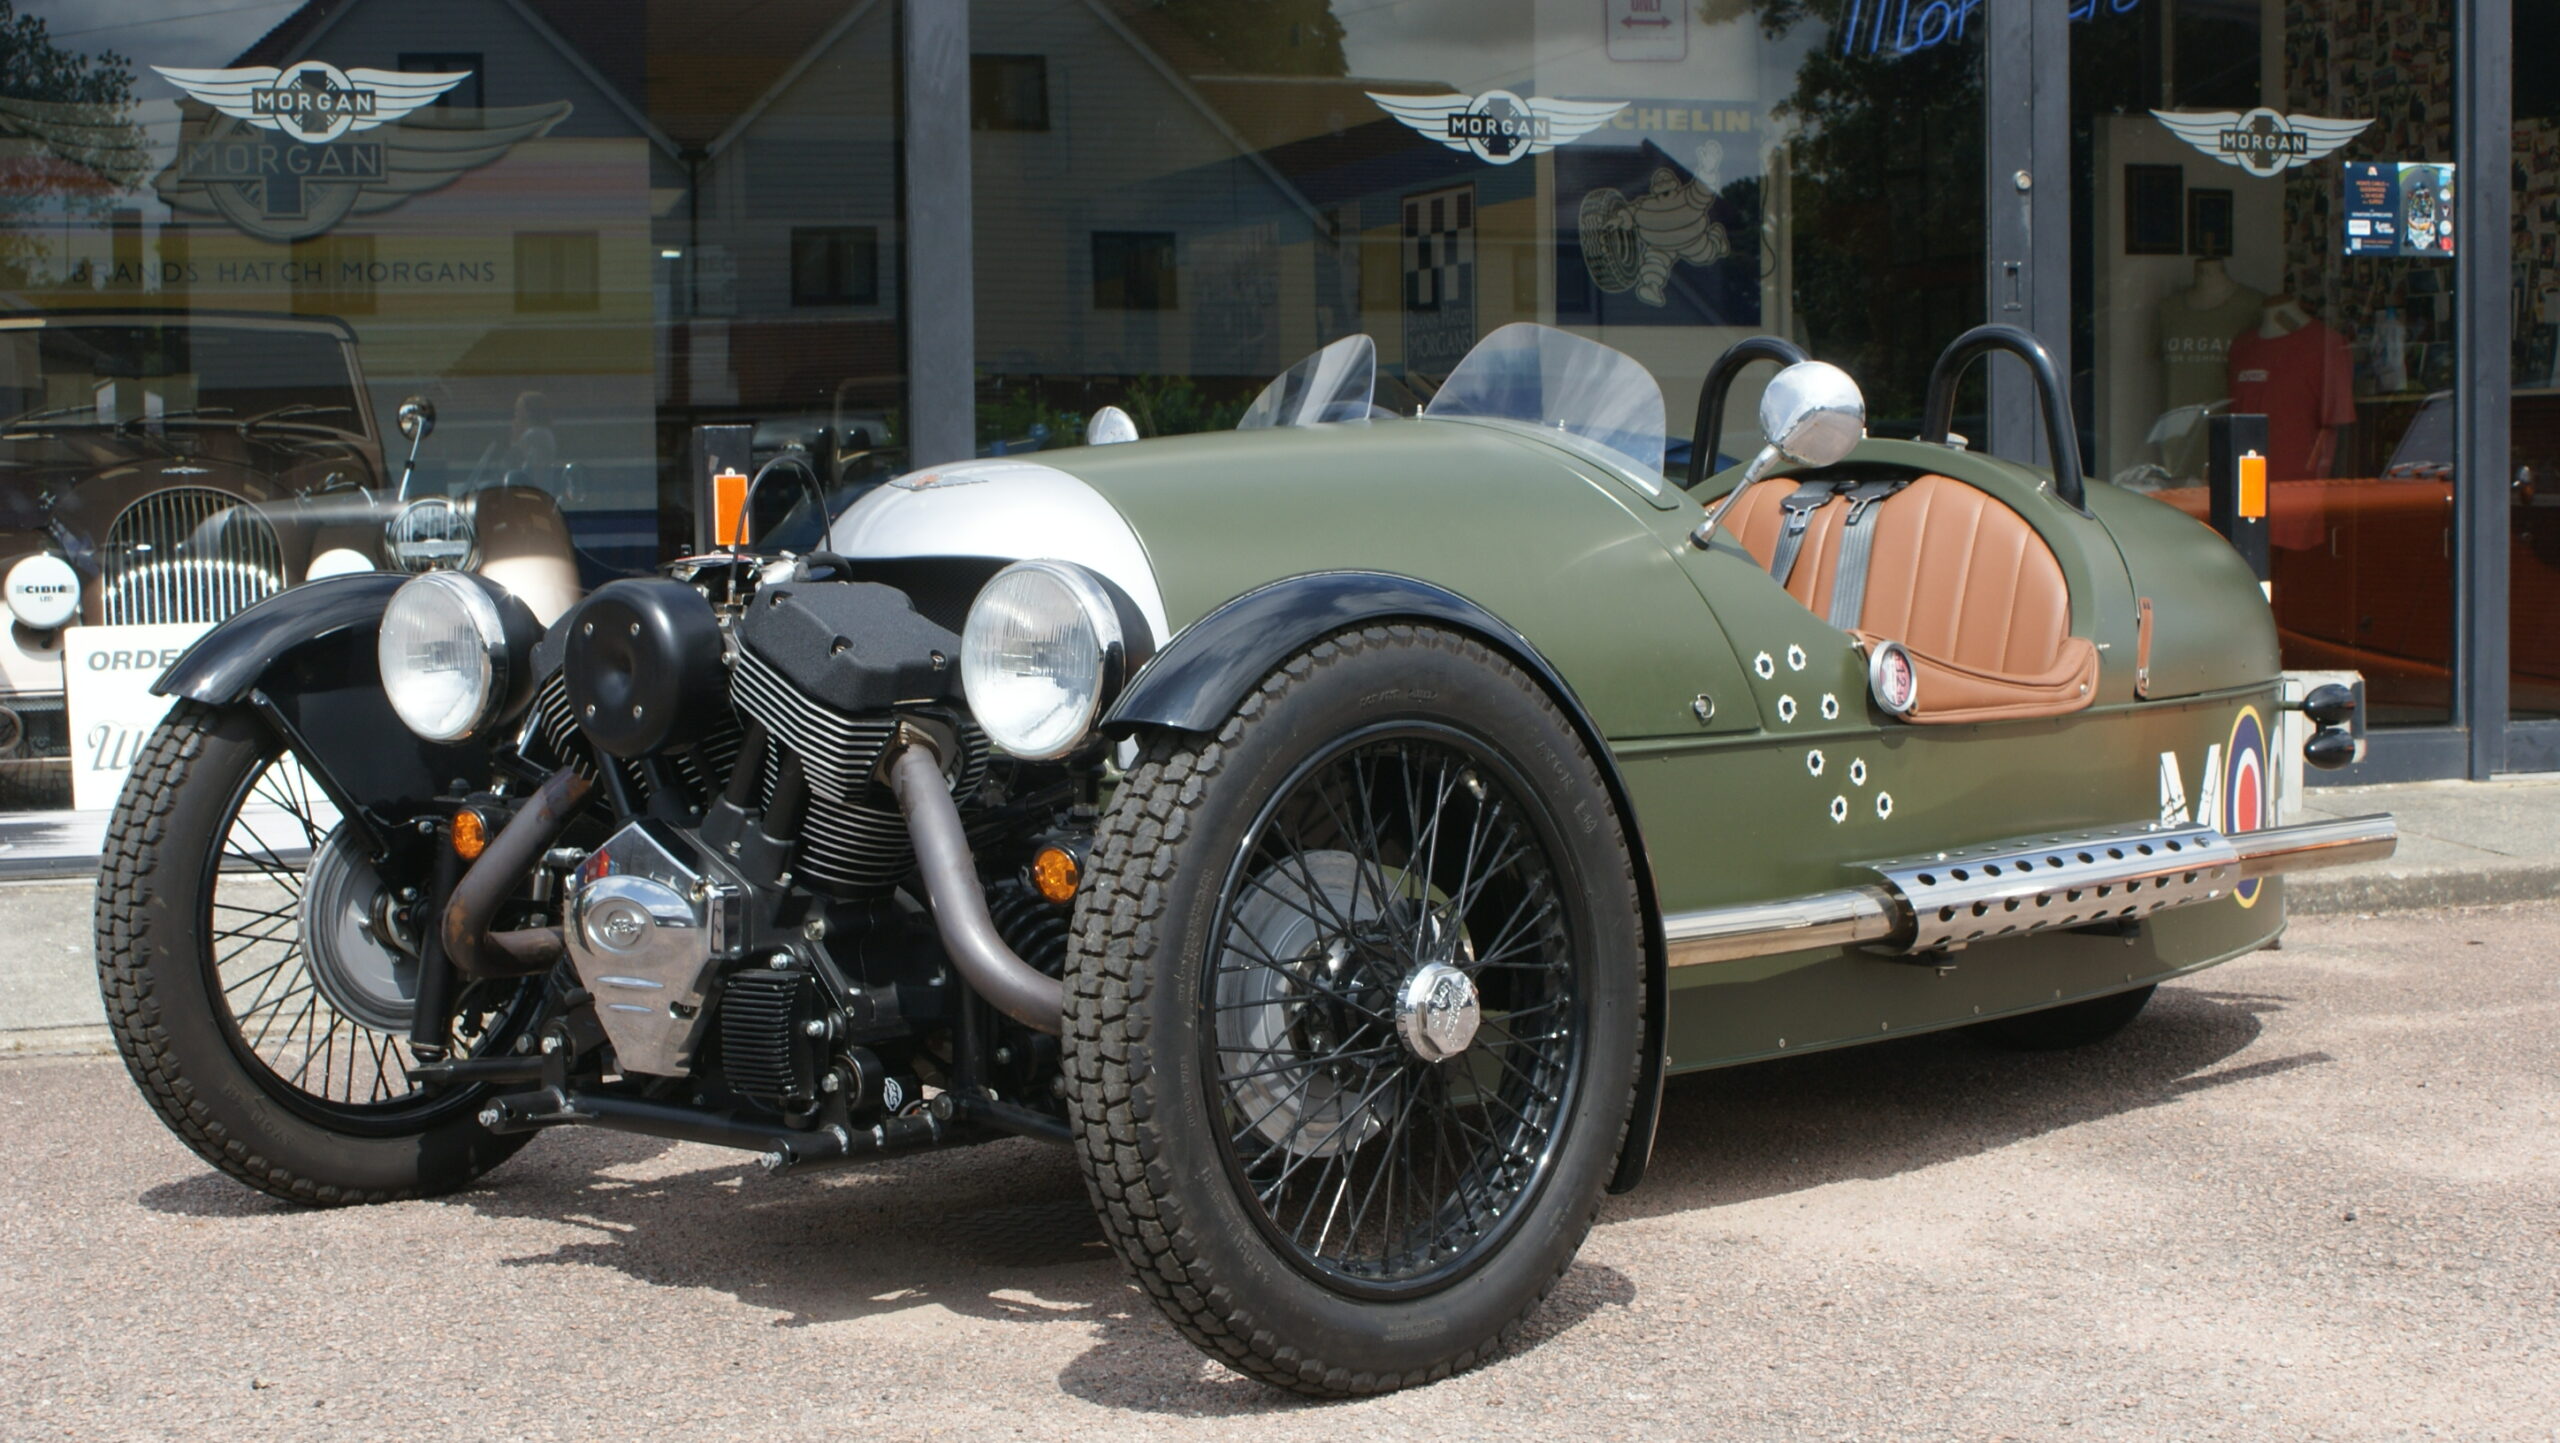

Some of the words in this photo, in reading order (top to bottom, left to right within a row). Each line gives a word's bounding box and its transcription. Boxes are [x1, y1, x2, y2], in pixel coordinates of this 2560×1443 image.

[256, 91, 372, 113] MORGAN
[1451, 117, 1548, 136] MORGAN
[1601, 107, 1750, 132] CHELIN
[2223, 133, 2304, 152] MORGAN
[187, 144, 378, 176] MORGAN
[73, 261, 199, 284] BRANDS
[218, 261, 323, 284] HATCH
[342, 261, 497, 284] MORGANS
[2164, 337, 2233, 353] ORGA
[88, 649, 186, 671] ORDE
